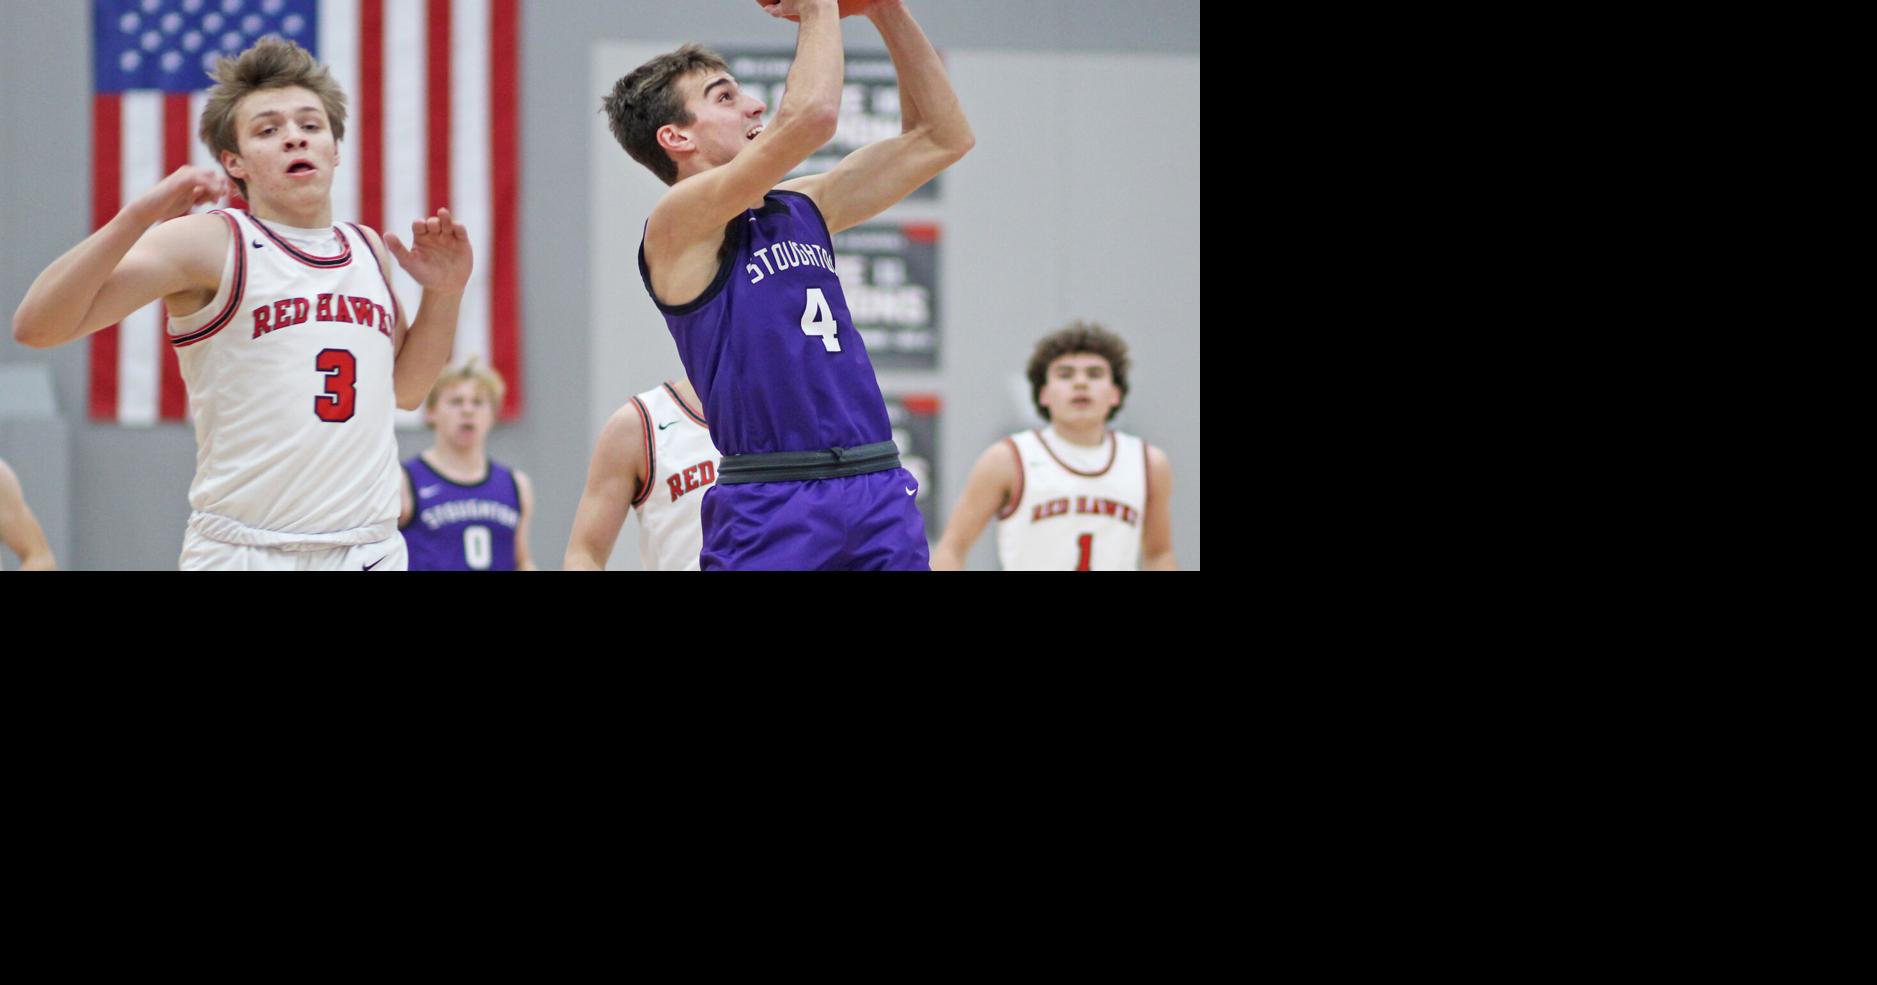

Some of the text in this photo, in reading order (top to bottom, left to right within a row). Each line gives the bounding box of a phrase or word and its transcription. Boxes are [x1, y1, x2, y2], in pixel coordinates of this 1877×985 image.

[746, 240, 837, 284] STOUGHTO
[252, 297, 309, 339] RED
[800, 287, 841, 352] 4
[314, 348, 356, 422] 3
[667, 460, 715, 503] RED
[1031, 497, 1069, 523] RED
[463, 525, 491, 571] 0
[1076, 533, 1093, 571] 1
